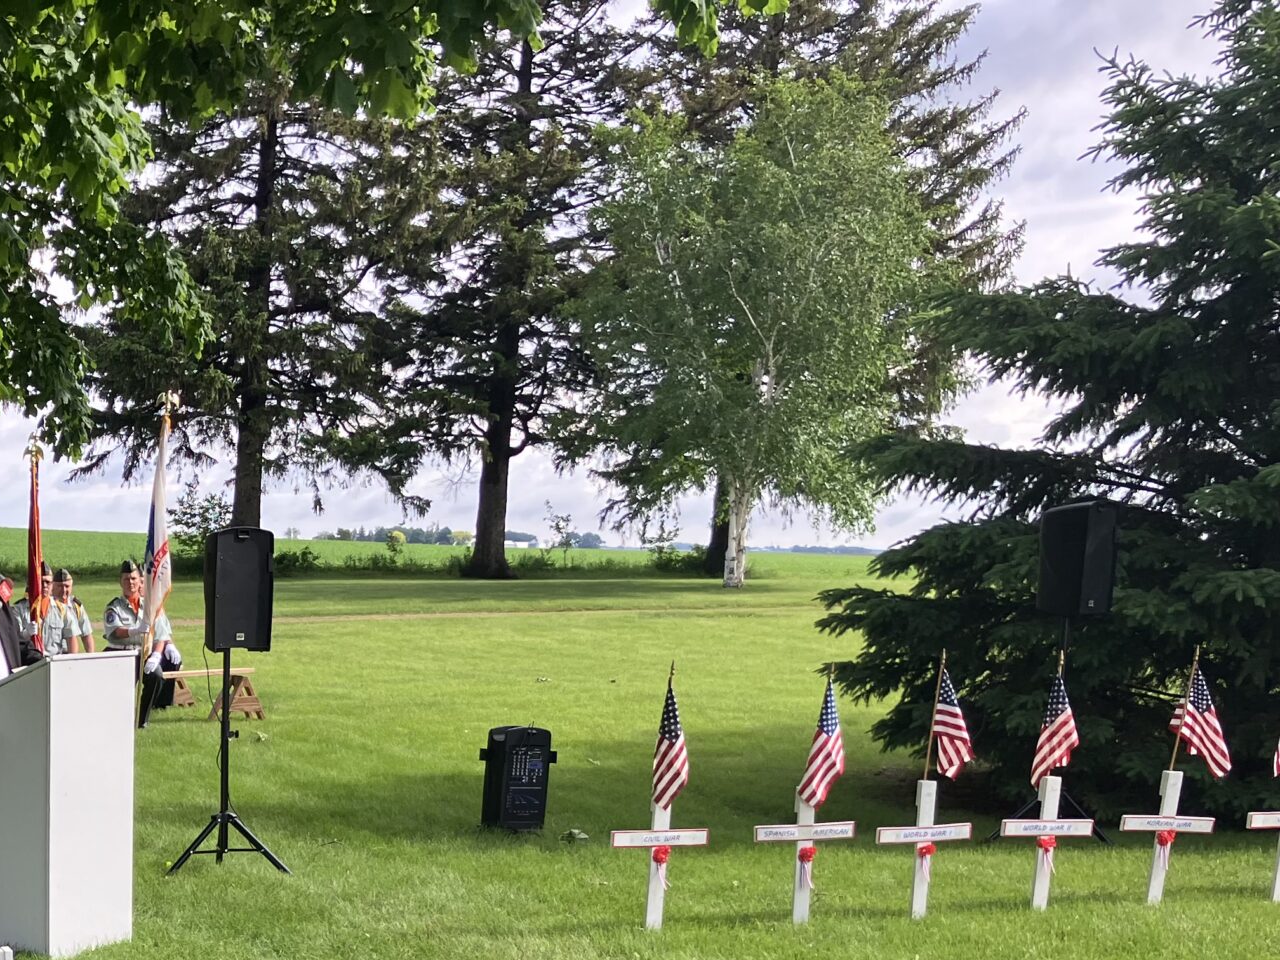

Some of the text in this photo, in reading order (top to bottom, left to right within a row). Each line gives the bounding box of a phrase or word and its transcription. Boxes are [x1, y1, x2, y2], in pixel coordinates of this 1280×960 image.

[1049, 824, 1065, 832] WAR
[1146, 820, 1175, 828] KOREAN
[763, 827, 849, 838] SPANISH AMERICAN
[903, 831, 928, 839] WORLD
[663, 834, 681, 842] WAR
